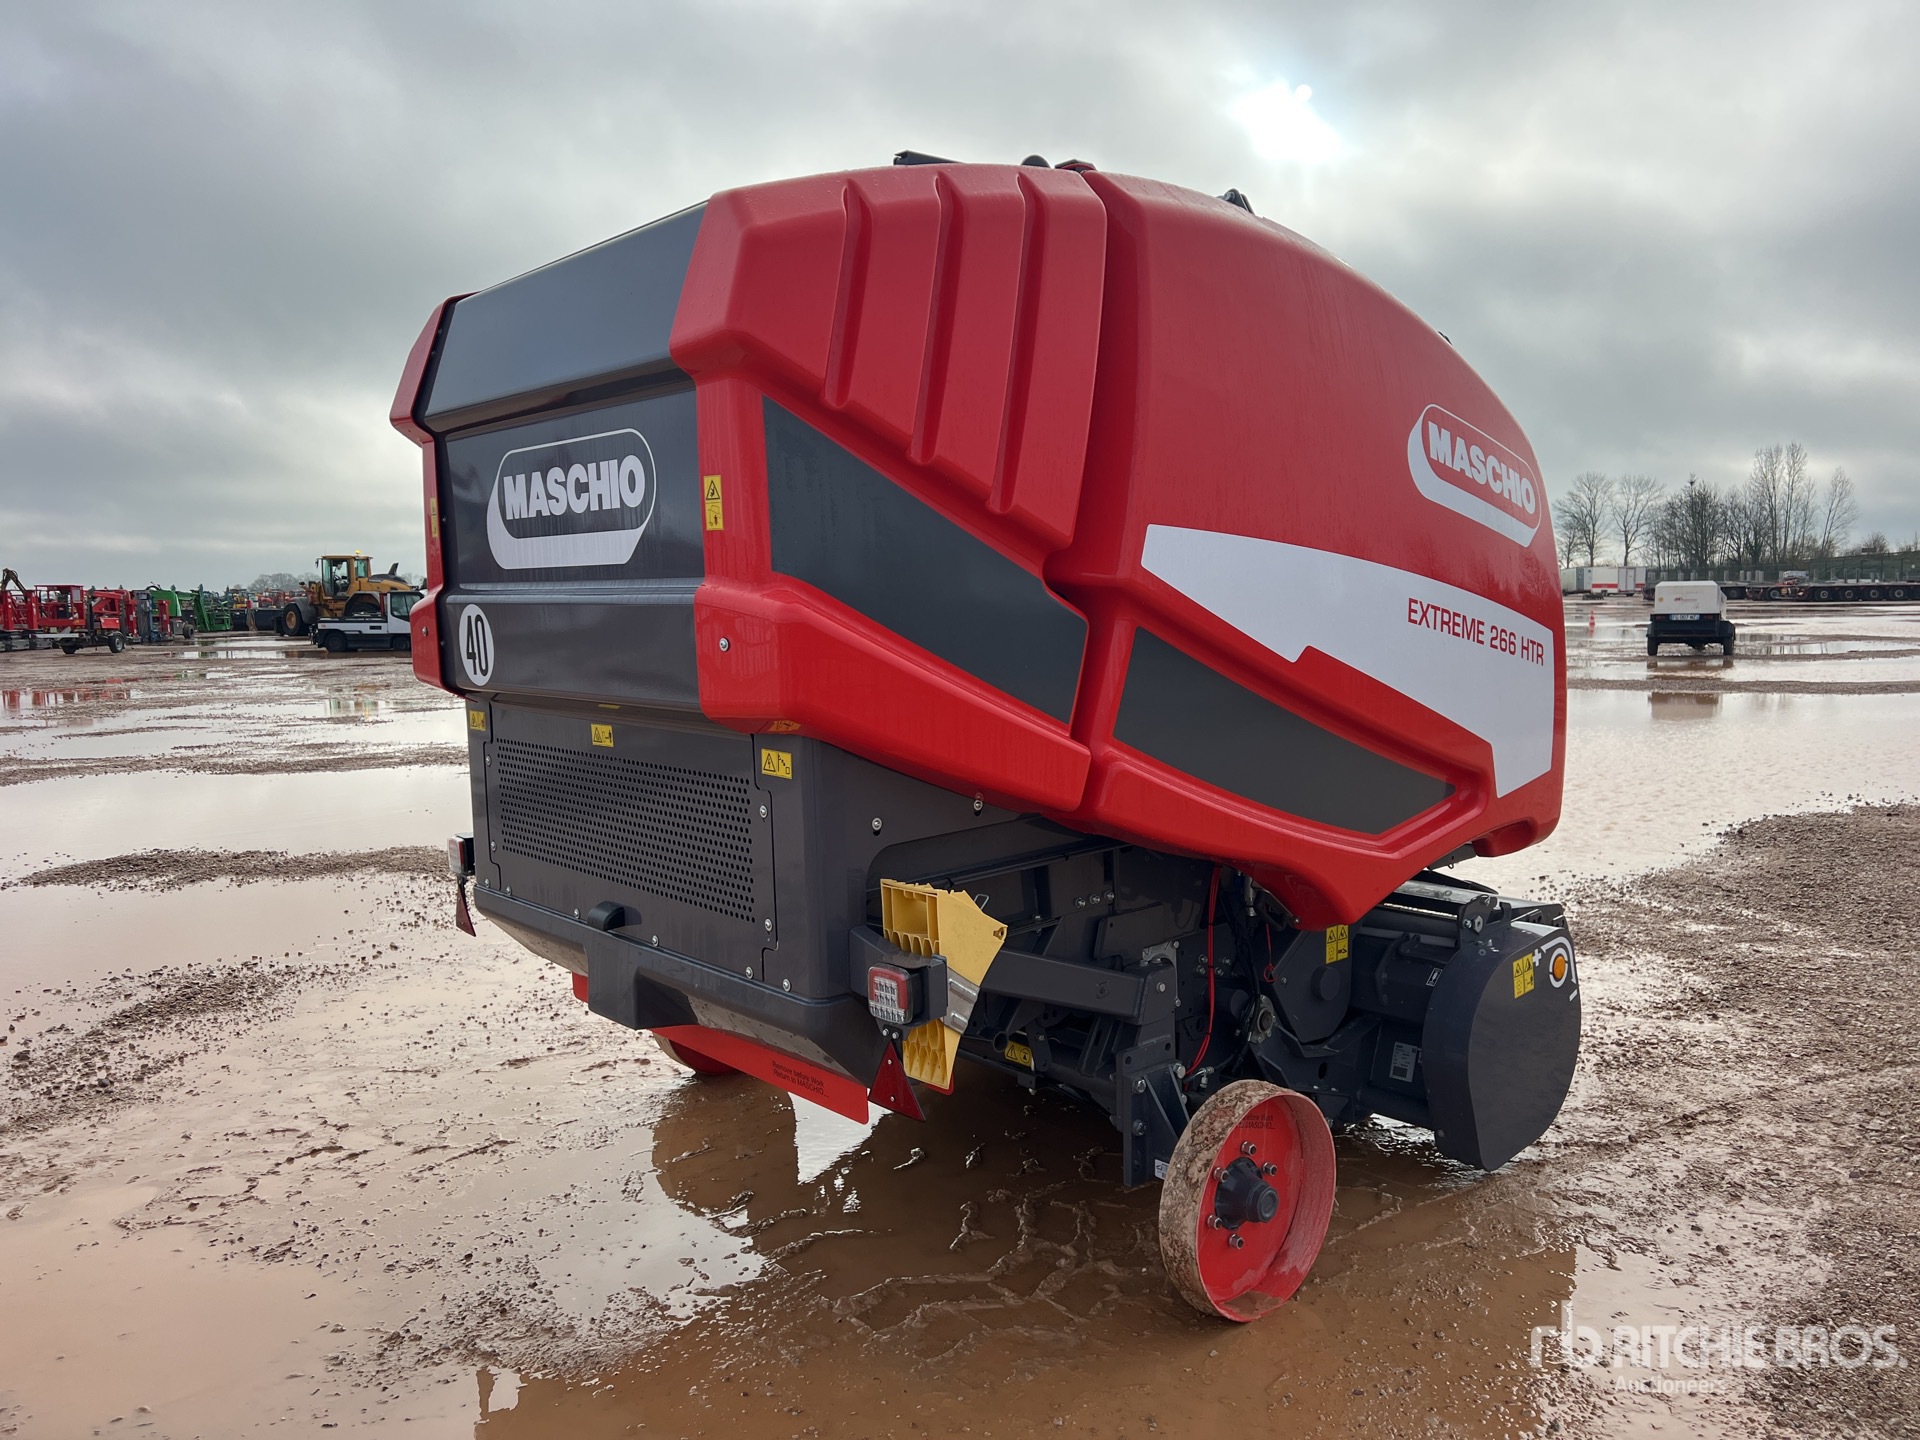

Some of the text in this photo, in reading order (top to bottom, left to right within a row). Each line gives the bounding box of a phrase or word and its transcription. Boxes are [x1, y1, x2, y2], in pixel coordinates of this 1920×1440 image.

[503, 455, 645, 520] MASCHIO
[1428, 420, 1536, 515] MASCHIO
[466, 614, 489, 677] 40
[1408, 597, 1544, 666] EXTREME 266 HTR
